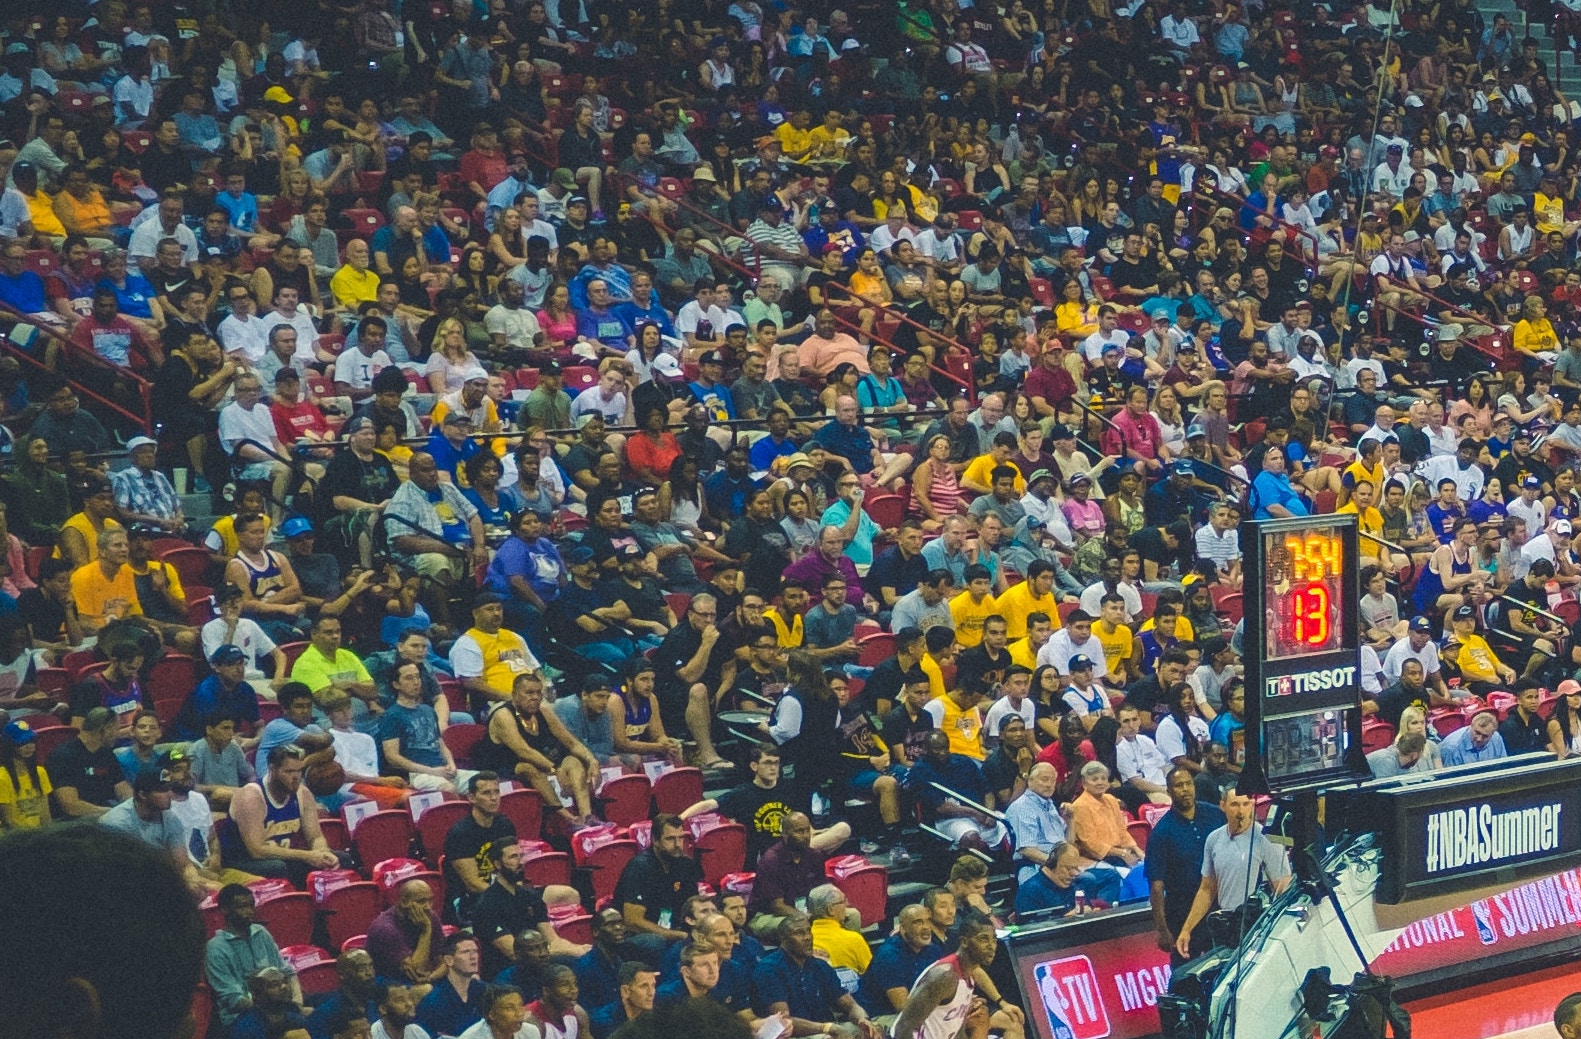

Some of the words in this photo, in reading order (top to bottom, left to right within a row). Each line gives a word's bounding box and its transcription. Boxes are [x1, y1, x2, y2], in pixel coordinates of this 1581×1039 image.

[1295, 582, 1331, 646] 13
[1291, 666, 1356, 693] TISSOT
[1425, 801, 1562, 874] #NBASummer
[1061, 973, 1098, 1025] TV
